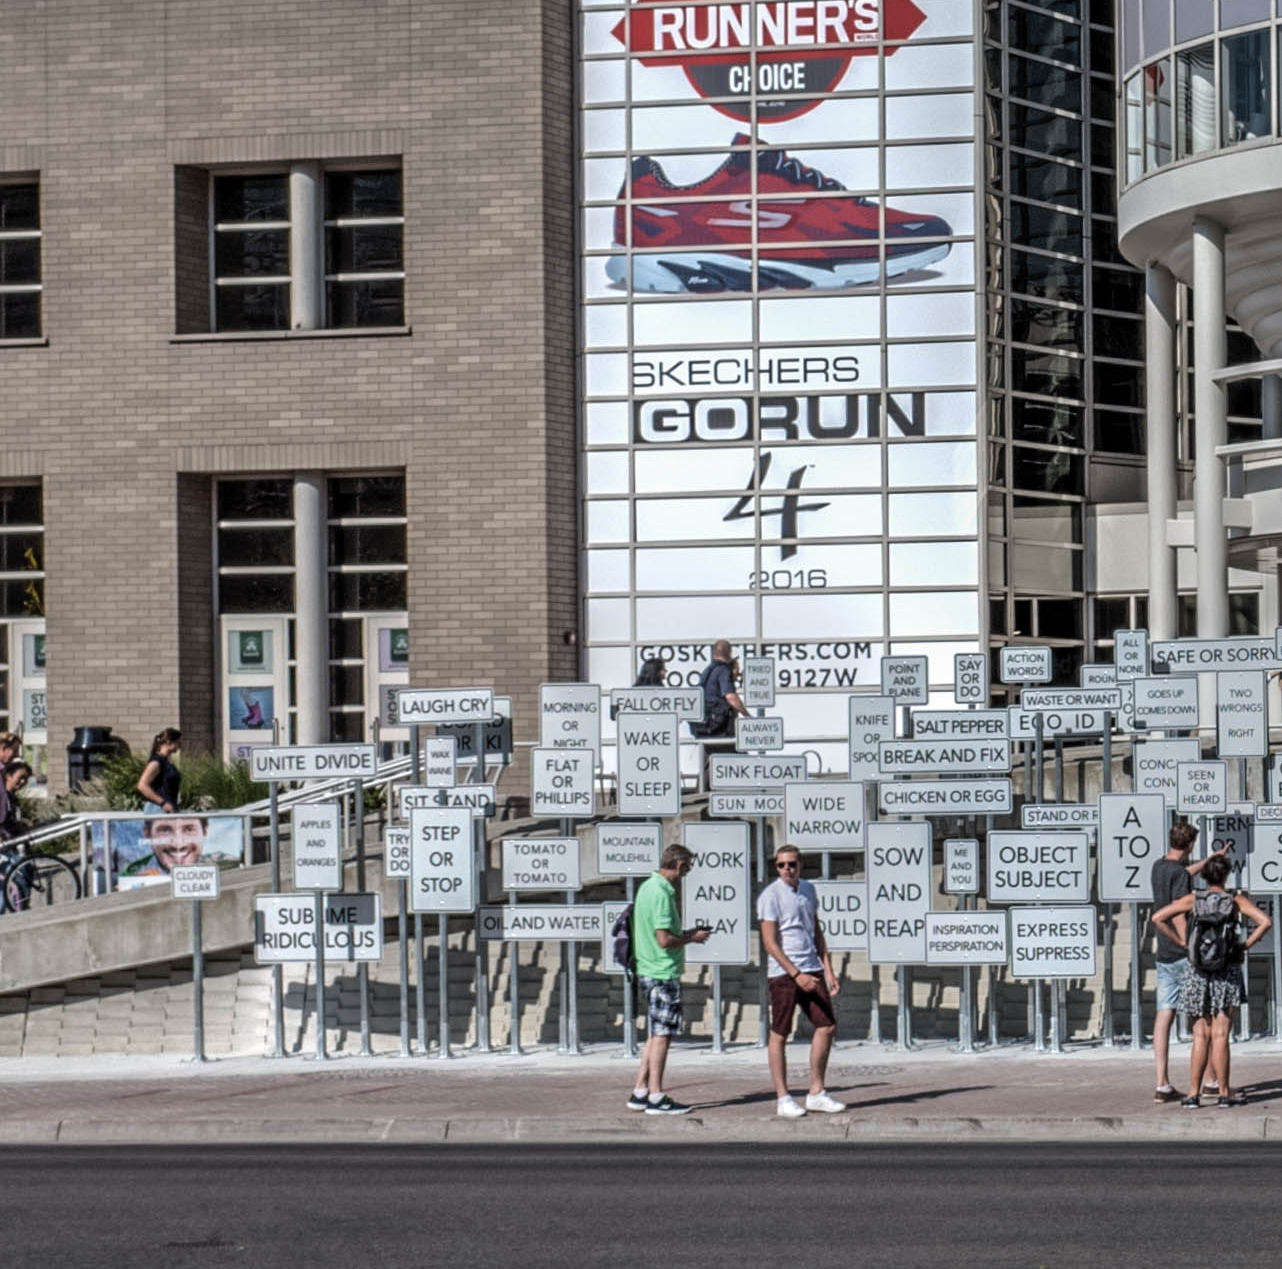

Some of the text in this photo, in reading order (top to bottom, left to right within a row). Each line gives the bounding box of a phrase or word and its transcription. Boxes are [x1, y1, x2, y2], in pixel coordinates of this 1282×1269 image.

[729, 63, 805, 92] CHOICE
[633, 356, 860, 388] SKECHERS
[723, 451, 831, 561] 4
[750, 570, 827, 590] 2016
[402, 698, 489, 715] LAUGH CRY
[855, 715, 888, 725] KNIFE
[624, 732, 671, 746] WAKE
[256, 753, 371, 771] UNITE DIVIDE
[884, 747, 1005, 764] BREAK AND FIX
[1187, 770, 1216, 781] SEEN
[626, 783, 672, 796] SLEEP
[802, 797, 846, 811] WIDE
[1183, 795, 1220, 805] HEARD
[422, 826, 461, 841] STEP
[789, 821, 861, 834] NARROW
[602, 837, 655, 847] MOUNTAIN
[515, 845, 566, 855] TOMATO
[873, 847, 924, 866] SOW
[999, 846, 1078, 864] OBJECT
[606, 853, 652, 863] MOLEHILL
[515, 873, 567, 883] TOMATO
[995, 871, 1083, 888] SUBJECT
[421, 878, 462, 893] STOP
[932, 924, 999, 935] INSPIRATION
[1017, 924, 1089, 938] EXPRESS
[929, 940, 1003, 952] PERSPIRATION
[1016, 947, 1090, 961] SUPPRESS
